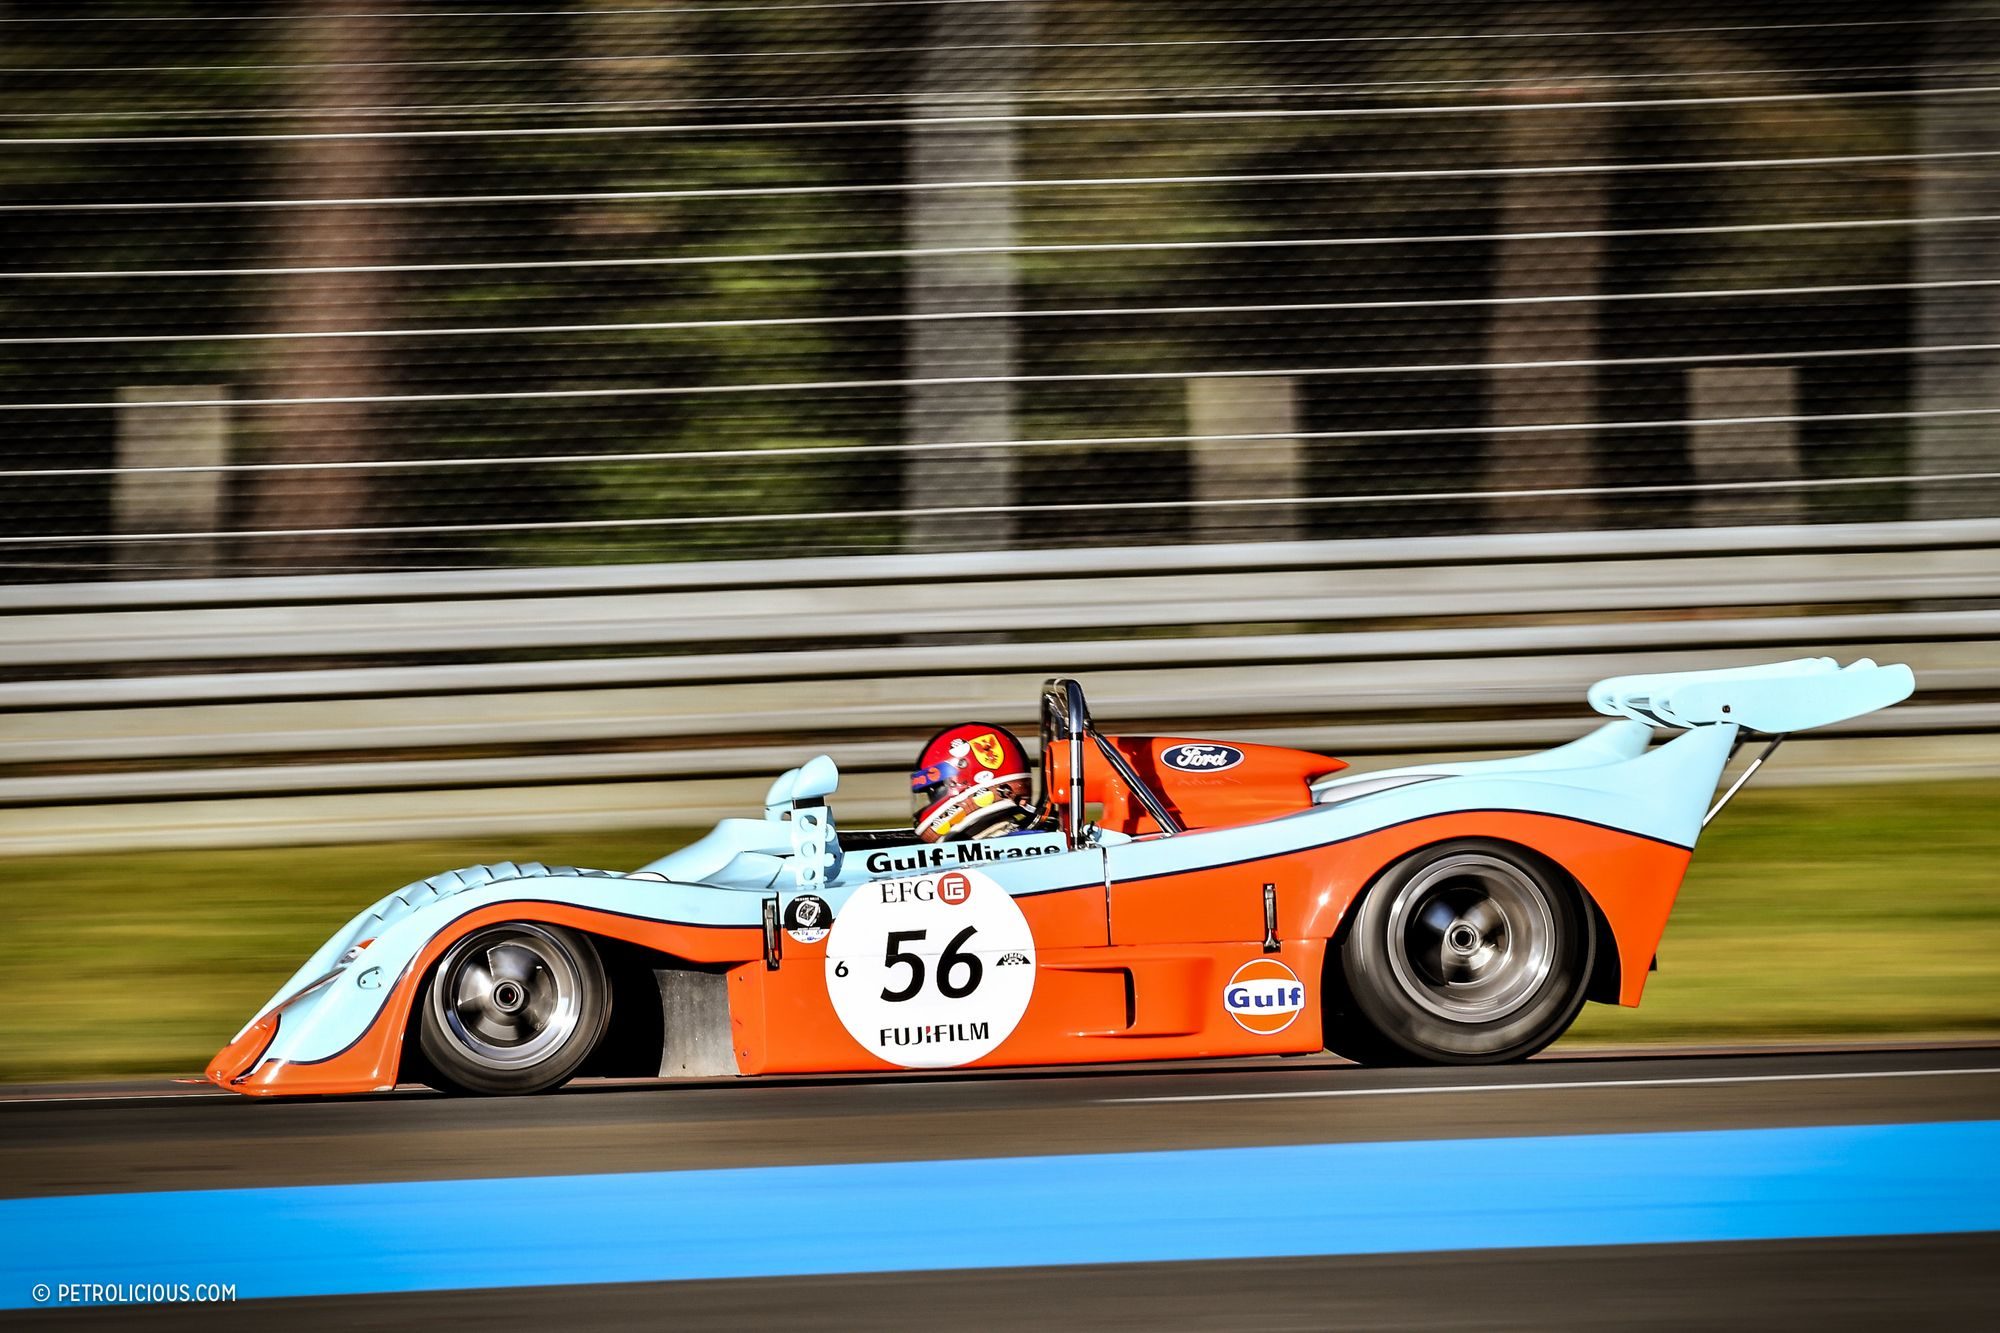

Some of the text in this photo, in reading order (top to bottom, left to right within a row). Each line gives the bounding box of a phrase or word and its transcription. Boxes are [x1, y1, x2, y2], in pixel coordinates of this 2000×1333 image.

[1176, 745, 1228, 767] Ford
[866, 842, 1061, 874] Gulf-Mirage
[880, 879, 935, 904] EFG
[834, 960, 849, 978] 6
[880, 925, 983, 1003] 56
[1227, 987, 1302, 1008] Gulf
[879, 1021, 990, 1047] FUJIFILM
